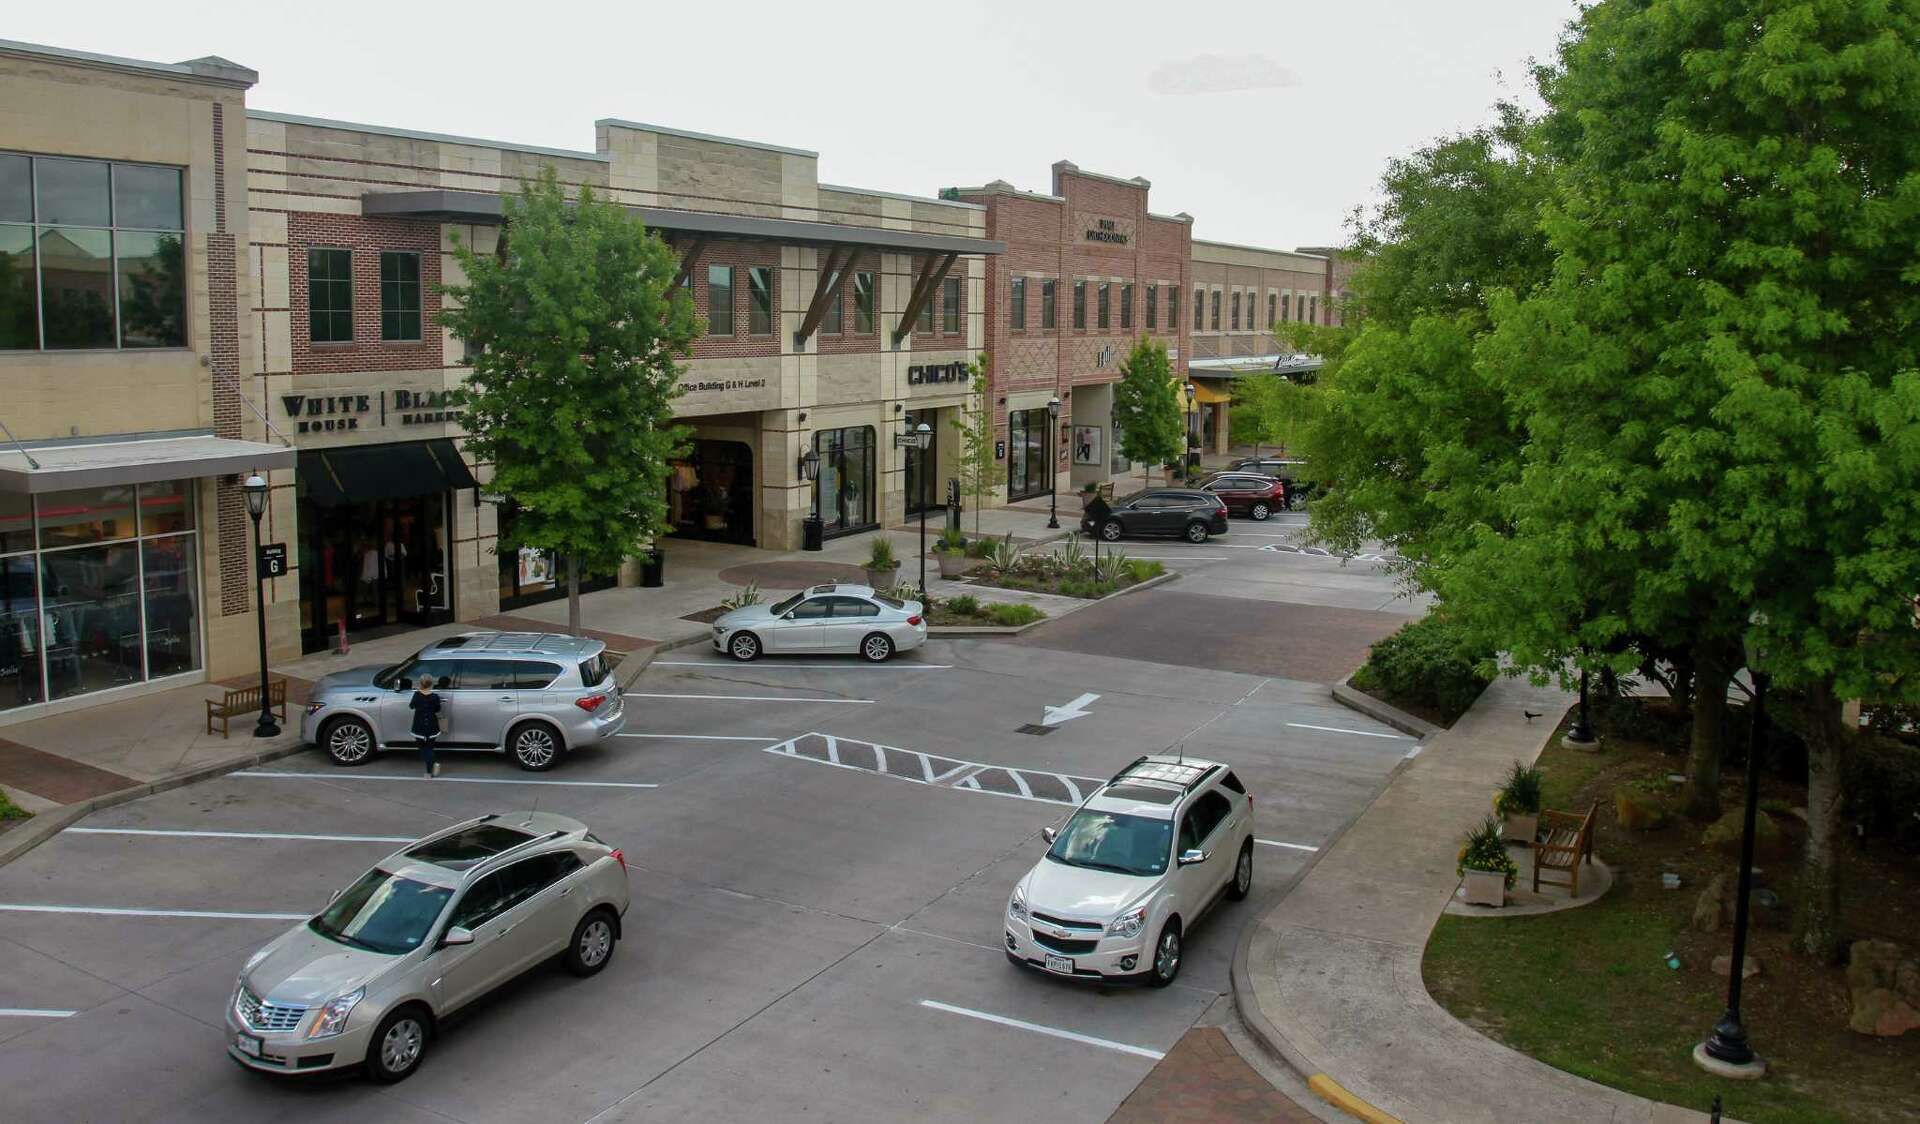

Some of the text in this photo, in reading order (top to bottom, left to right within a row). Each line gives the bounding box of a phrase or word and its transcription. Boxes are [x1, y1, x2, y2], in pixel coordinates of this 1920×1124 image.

[908, 361, 969, 384] CHICO'S
[678, 382, 697, 392] Office
[698, 381, 724, 392] Building
[282, 389, 469, 417] WHITE BLAC
[298, 418, 358, 434] HOUSE
[270, 560, 279, 573] G
